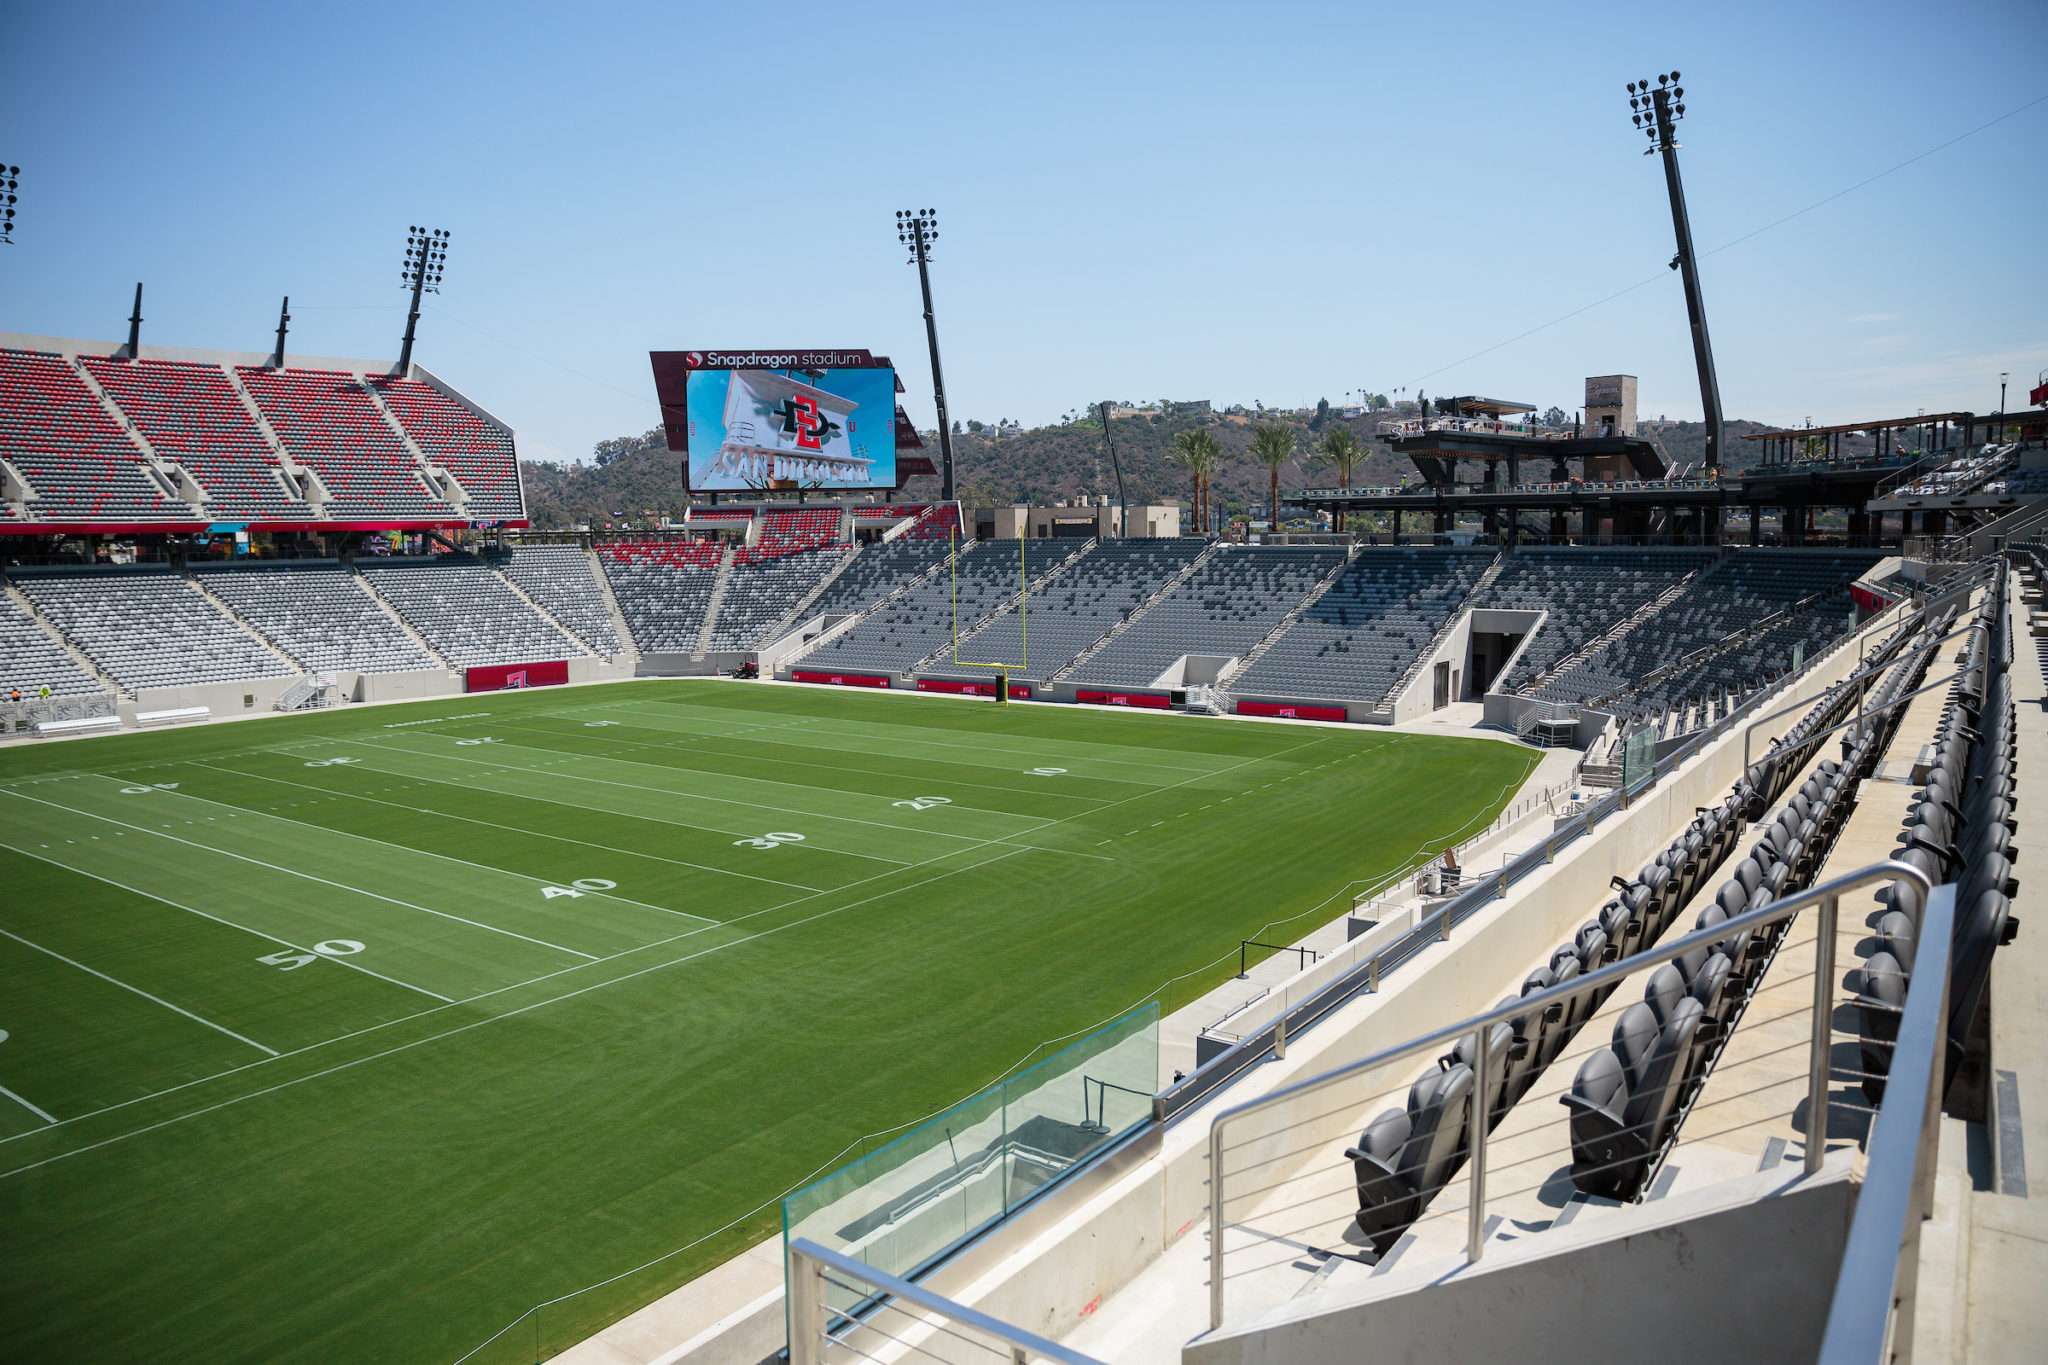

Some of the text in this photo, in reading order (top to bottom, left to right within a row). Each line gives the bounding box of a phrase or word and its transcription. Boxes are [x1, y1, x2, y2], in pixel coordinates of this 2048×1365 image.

[707, 352, 861, 368] Snapdragon stadium
[720, 451, 768, 480] SAN
[773, 455, 831, 481] DIEGO
[891, 796, 952, 810] 20
[732, 832, 806, 850] 30
[540, 878, 617, 899] 40
[255, 939, 366, 971] 50
